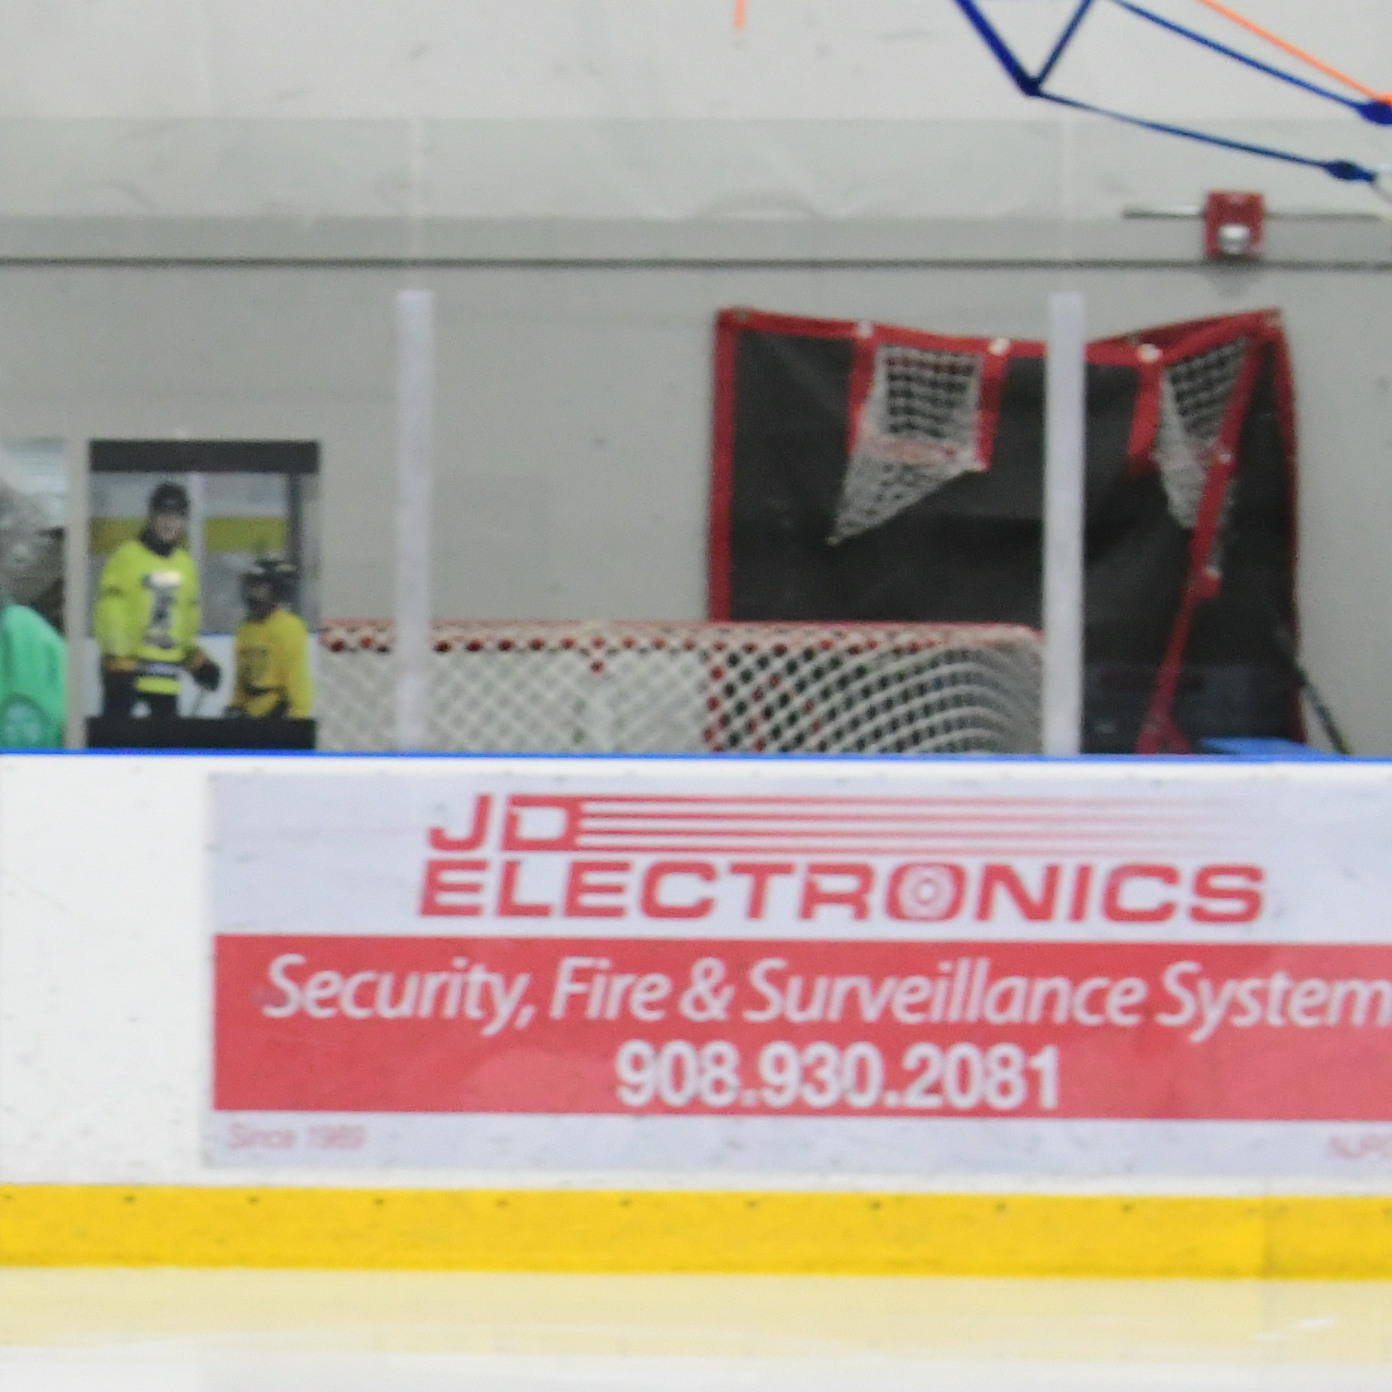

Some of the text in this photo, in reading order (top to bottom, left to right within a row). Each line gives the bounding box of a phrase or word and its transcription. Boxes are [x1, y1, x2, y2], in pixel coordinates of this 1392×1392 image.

[428, 794, 582, 853] JD
[420, 858, 1265, 924] ELECTRONICS
[262, 952, 536, 1038] Security,
[550, 955, 672, 1022] Fire
[678, 956, 734, 1023] &
[743, 956, 1148, 1028] Surveillance
[615, 1039, 1061, 1110] 908.930.2081
